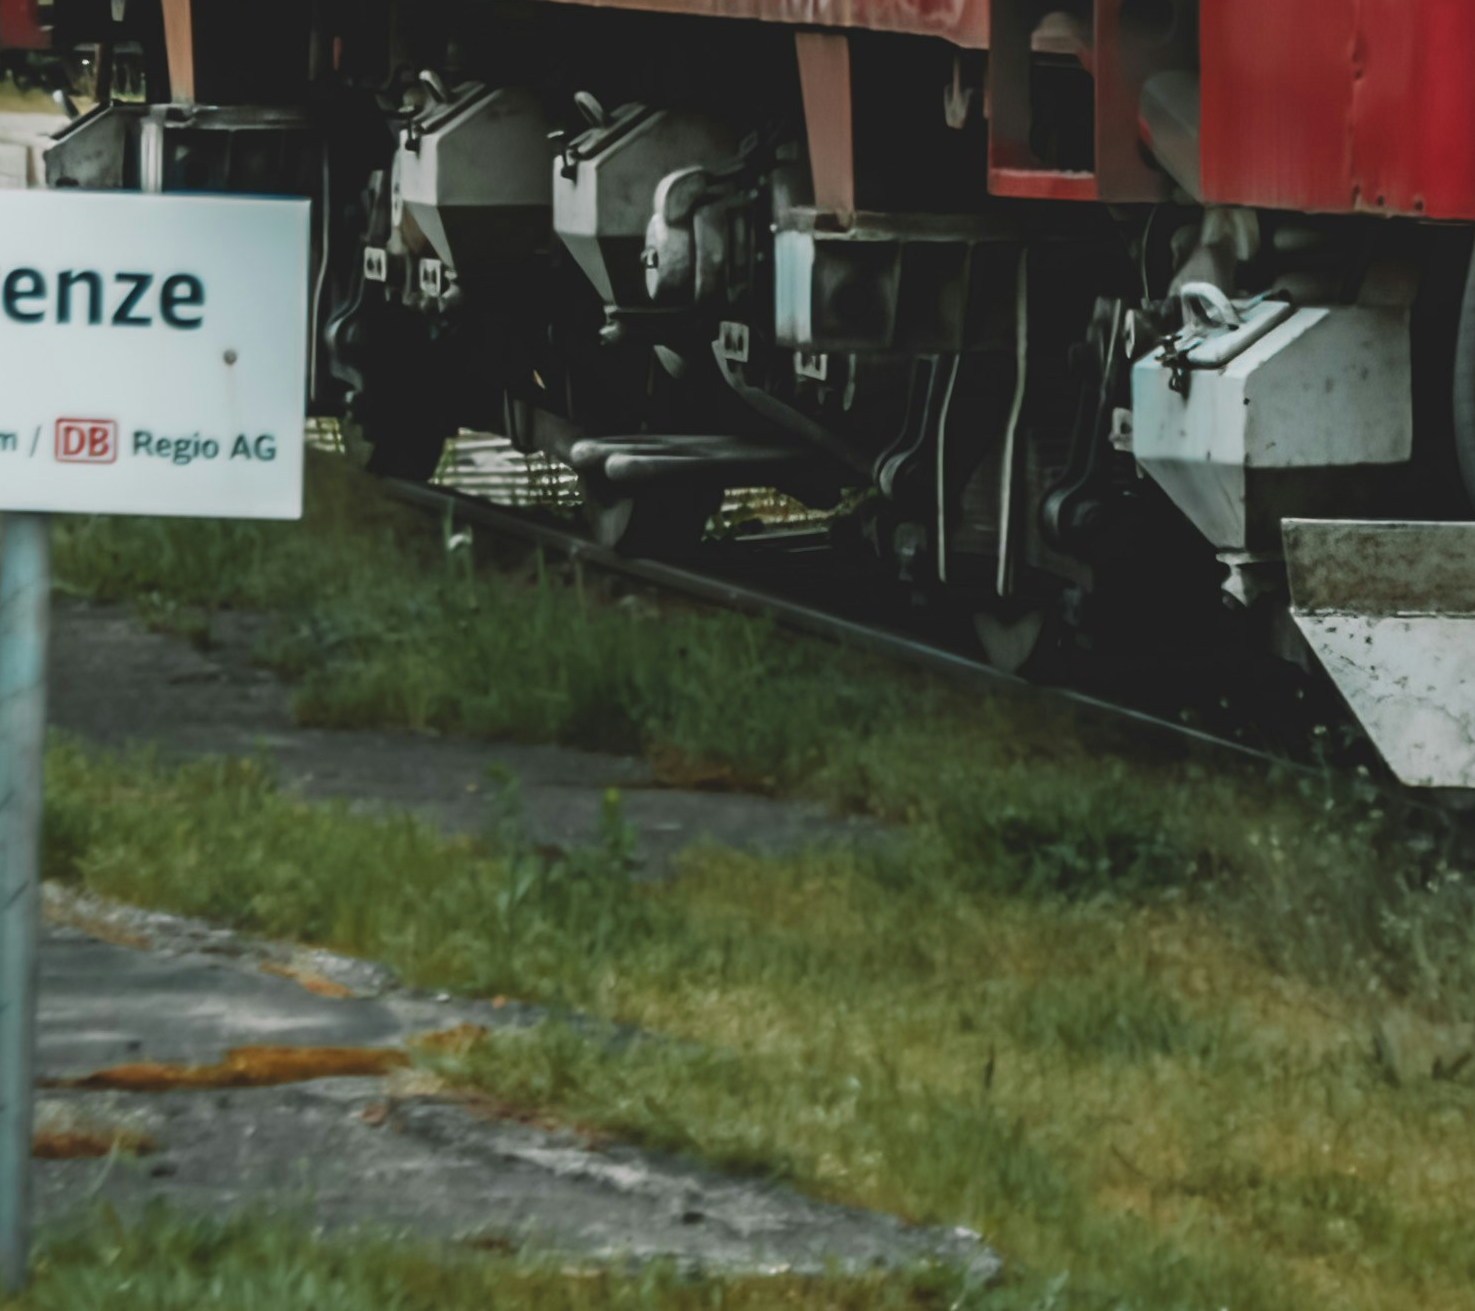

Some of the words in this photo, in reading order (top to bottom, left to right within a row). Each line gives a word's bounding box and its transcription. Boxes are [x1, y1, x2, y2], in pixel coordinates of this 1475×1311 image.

[60, 423, 111, 459] DB
[132, 430, 219, 466] Regio
[230, 434, 277, 462] AG
